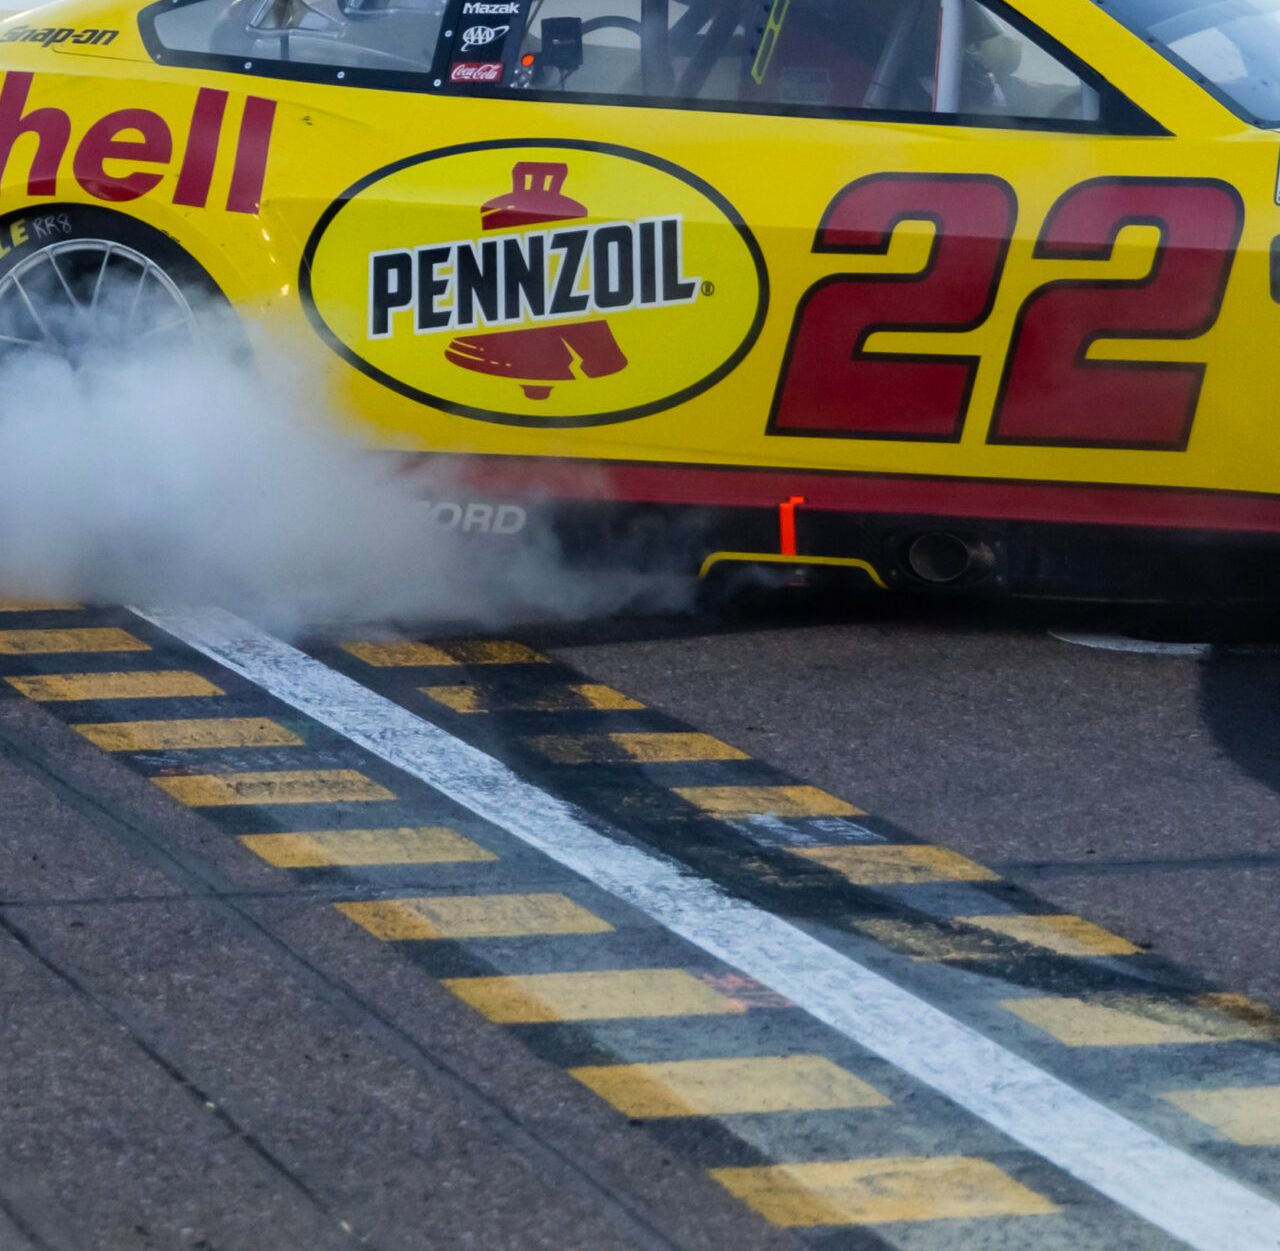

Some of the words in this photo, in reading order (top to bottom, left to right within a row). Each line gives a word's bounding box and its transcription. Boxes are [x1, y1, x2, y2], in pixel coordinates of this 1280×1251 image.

[462, 2, 520, 15] Mazak
[466, 26, 491, 45] AAA
[371, 216, 699, 338] PENNZOIL
[765, 171, 1246, 452] 22
[420, 500, 527, 535] ORD
